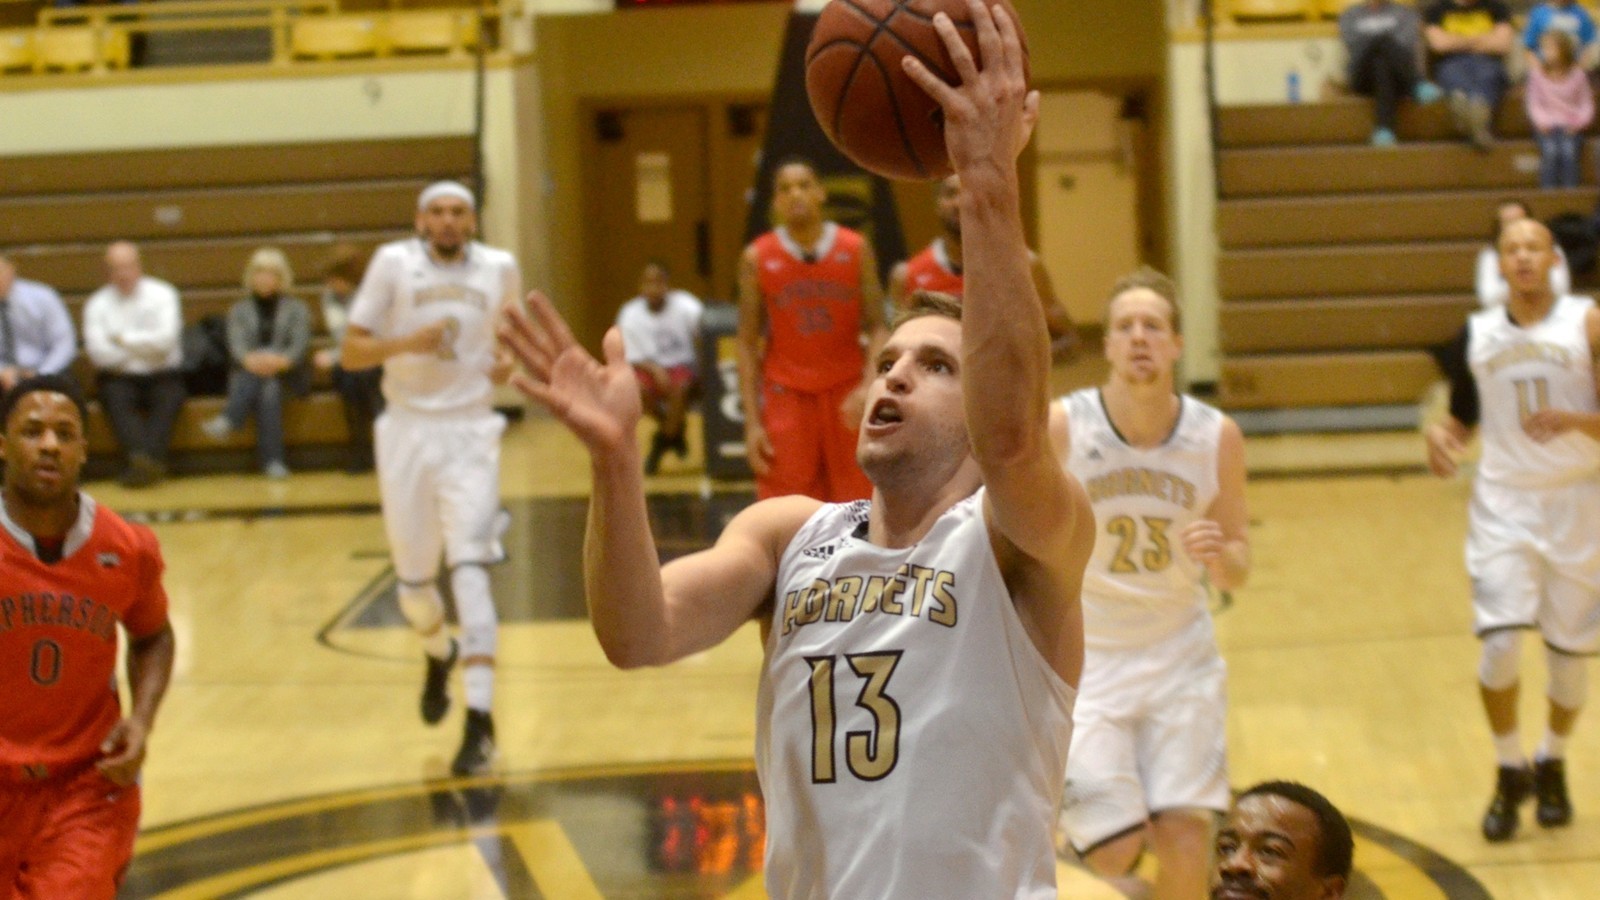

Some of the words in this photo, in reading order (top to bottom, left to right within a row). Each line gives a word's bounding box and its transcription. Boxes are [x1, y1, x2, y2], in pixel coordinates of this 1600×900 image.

[1106, 515, 1173, 574] 23
[0, 592, 121, 638] PHERSO
[782, 563, 957, 636] HORNETS
[31, 638, 61, 686] 0
[803, 650, 904, 784] 13
